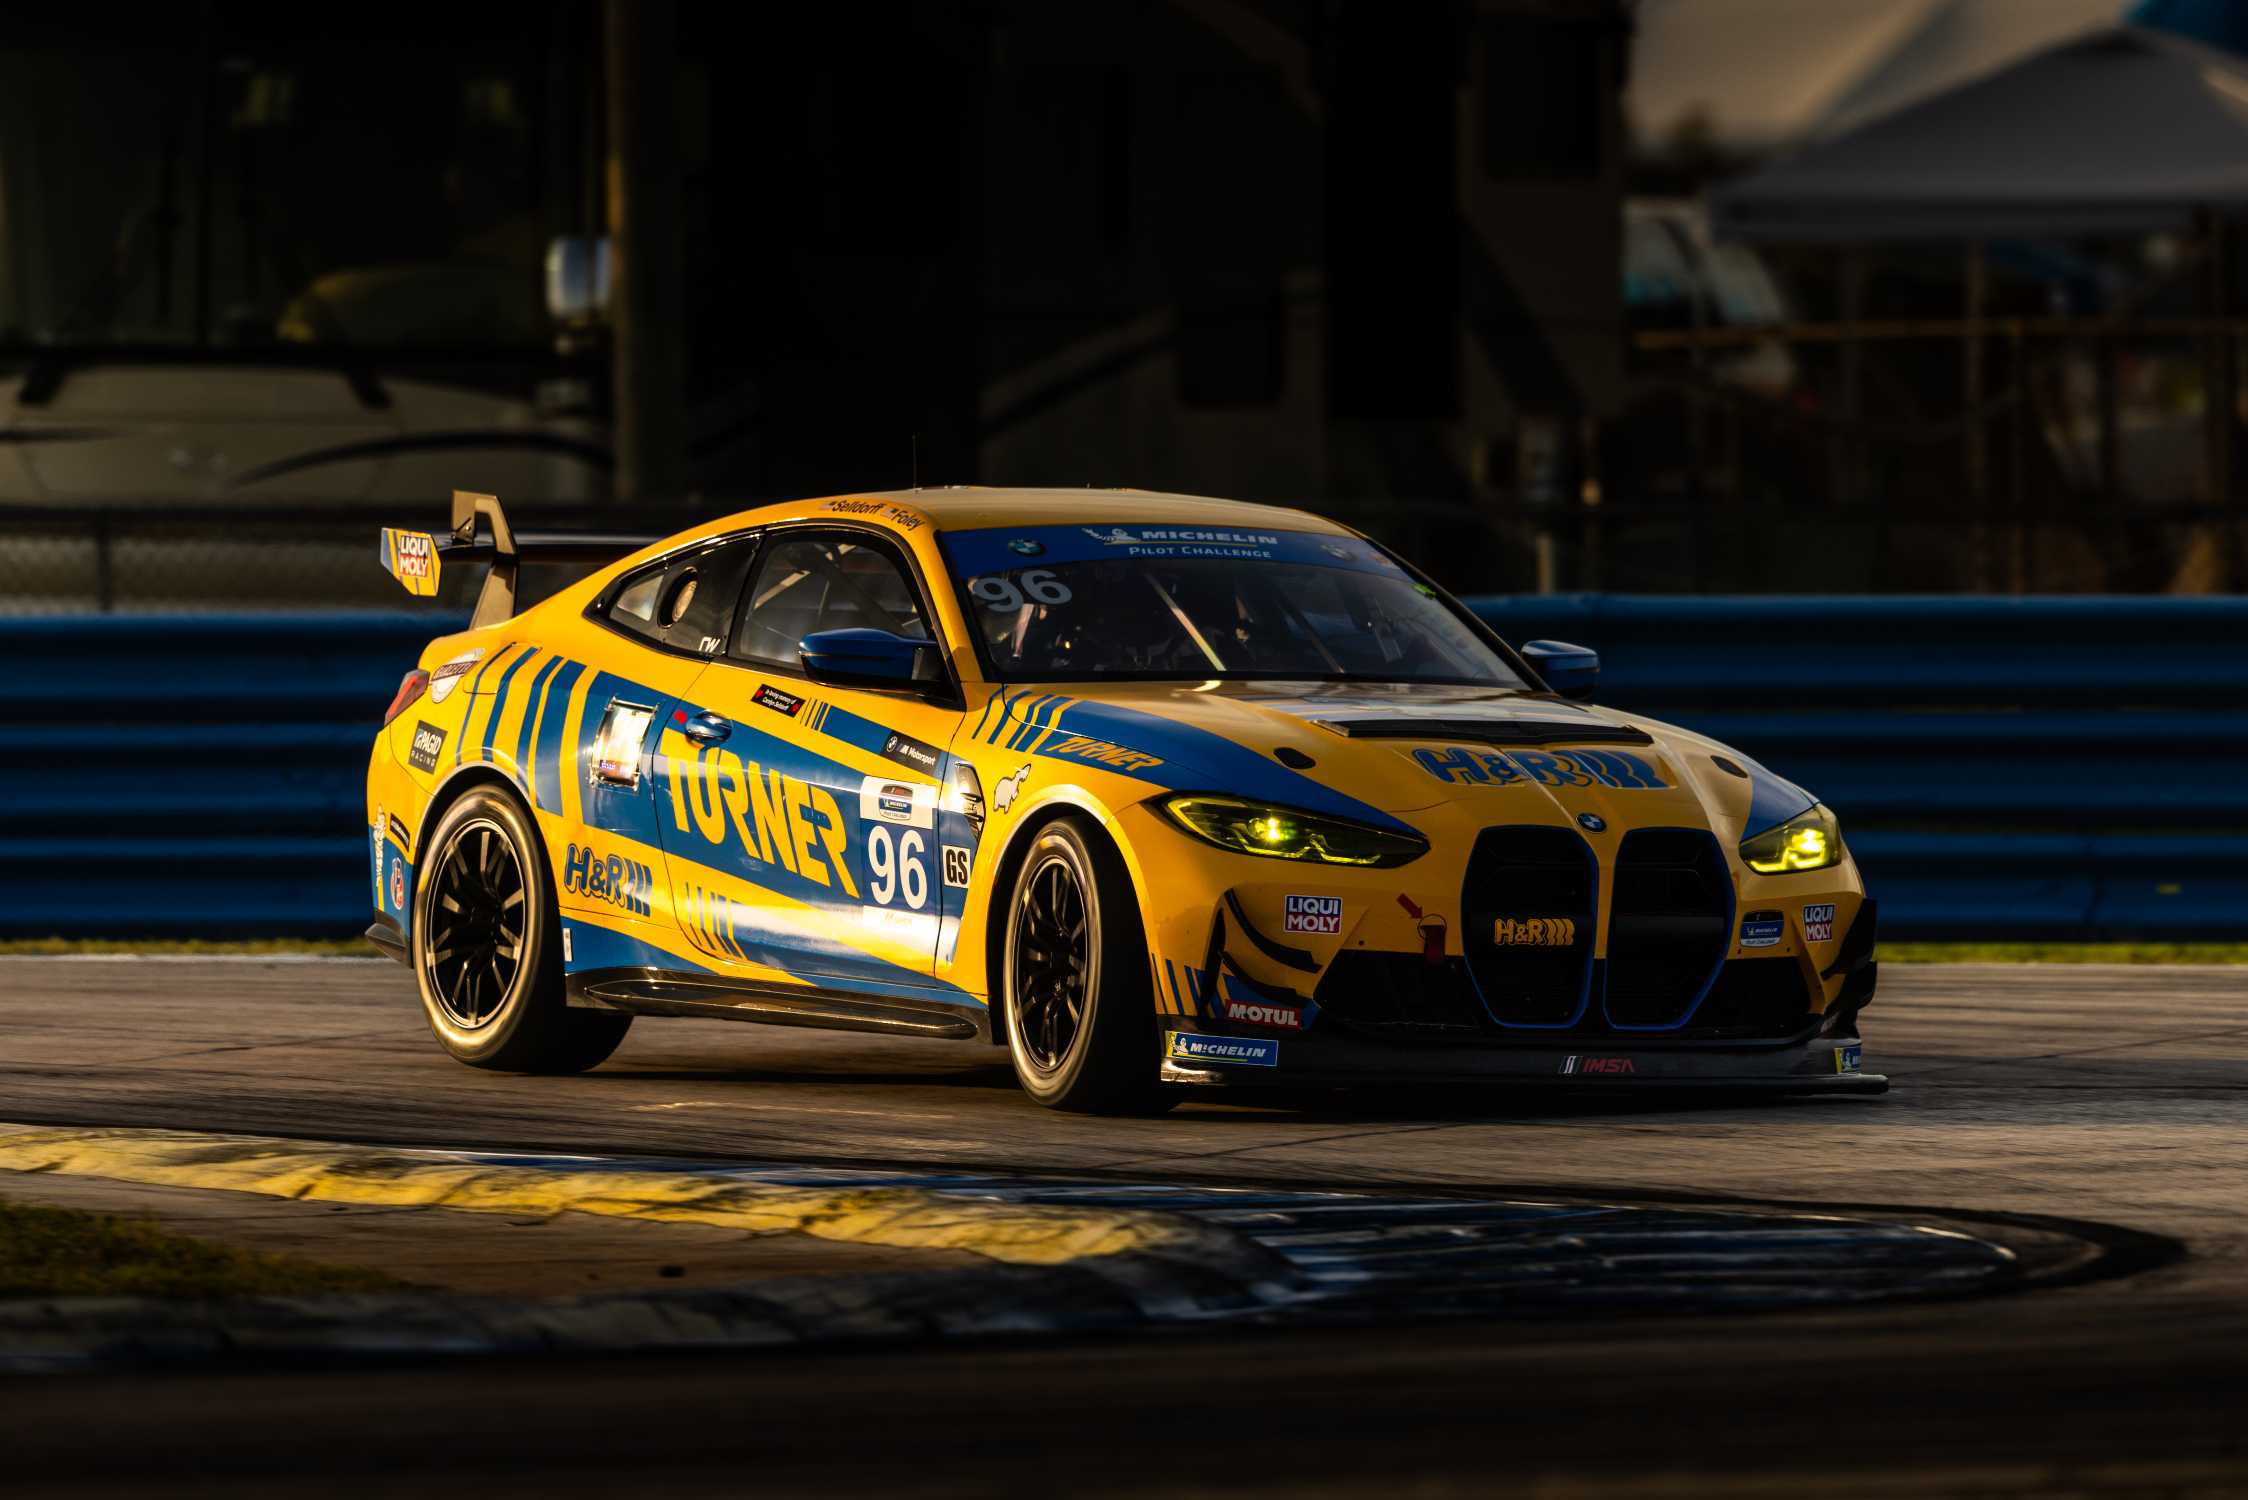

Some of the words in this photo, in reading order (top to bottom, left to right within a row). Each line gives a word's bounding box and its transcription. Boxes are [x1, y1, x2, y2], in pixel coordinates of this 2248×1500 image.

[832, 500, 887, 514] Selldorff
[891, 510, 925, 531] Foley
[400, 536, 429, 557] LIQUI
[1142, 531, 1278, 545] MICHELIN
[400, 557, 428, 577] MOLY
[972, 570, 1072, 612] 96
[420, 731, 443, 755] PAGID
[1045, 736, 1164, 771] TURNER
[410, 750, 437, 768] RACING
[908, 747, 936, 766] Motorsport
[1411, 748, 1592, 788] H&R
[659, 727, 860, 898] TURNER
[564, 843, 627, 908] H&R
[868, 826, 927, 909] 96
[946, 849, 968, 885] GS
[1288, 897, 1338, 915] LIQUI
[1804, 907, 1834, 922] LIQUI
[1287, 916, 1339, 932] MOLY
[1494, 918, 1548, 946] H&R
[1806, 923, 1832, 940] MOLY
[1228, 1003, 1298, 1026] MOTUL
[1190, 1042, 1267, 1057] MICHELIN
[1582, 1058, 1635, 1073] IMSA
